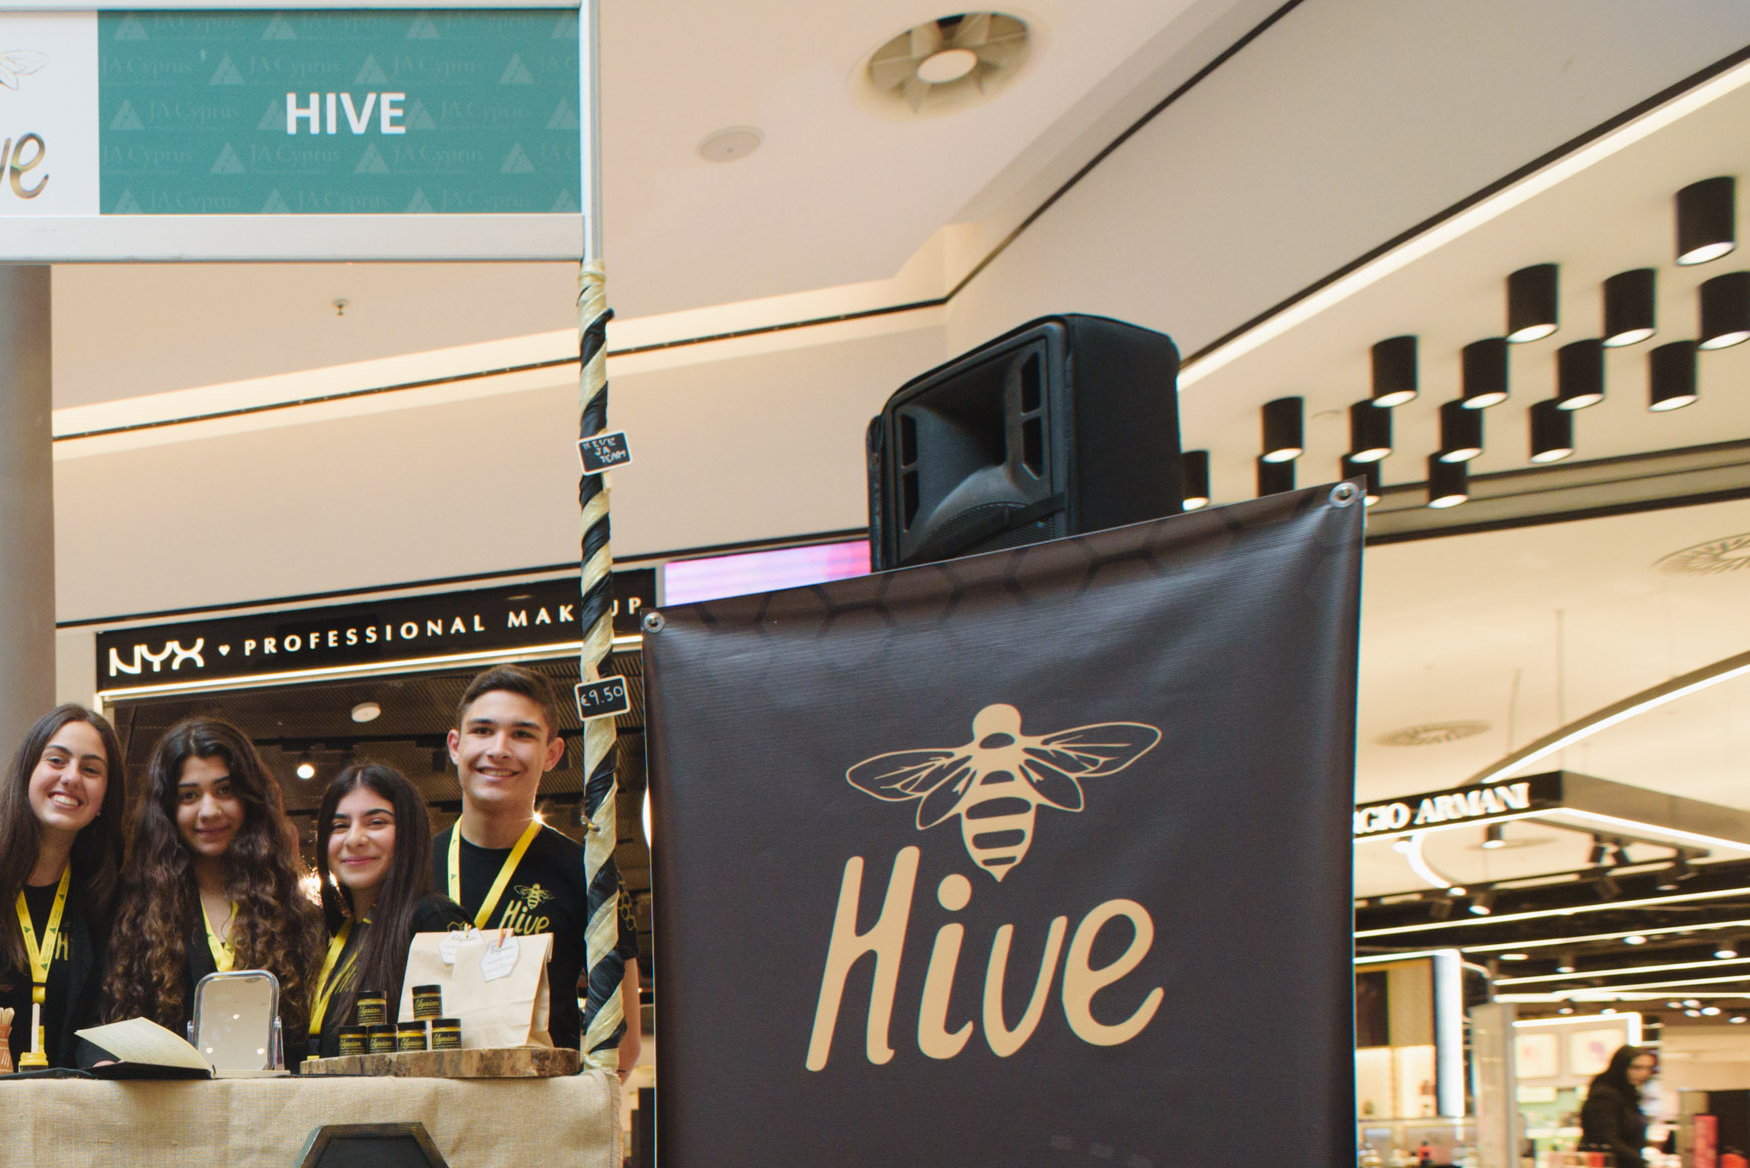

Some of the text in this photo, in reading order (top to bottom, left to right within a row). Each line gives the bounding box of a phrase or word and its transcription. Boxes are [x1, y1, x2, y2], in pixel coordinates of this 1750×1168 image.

[286, 92, 406, 135] HIVE
[108, 637, 205, 677] NYX
[244, 614, 485, 656] PROFESSIONAL
[580, 686, 624, 706] €9.50
[1413, 782, 1531, 825] ARMANI
[805, 845, 1164, 1072] Hive
